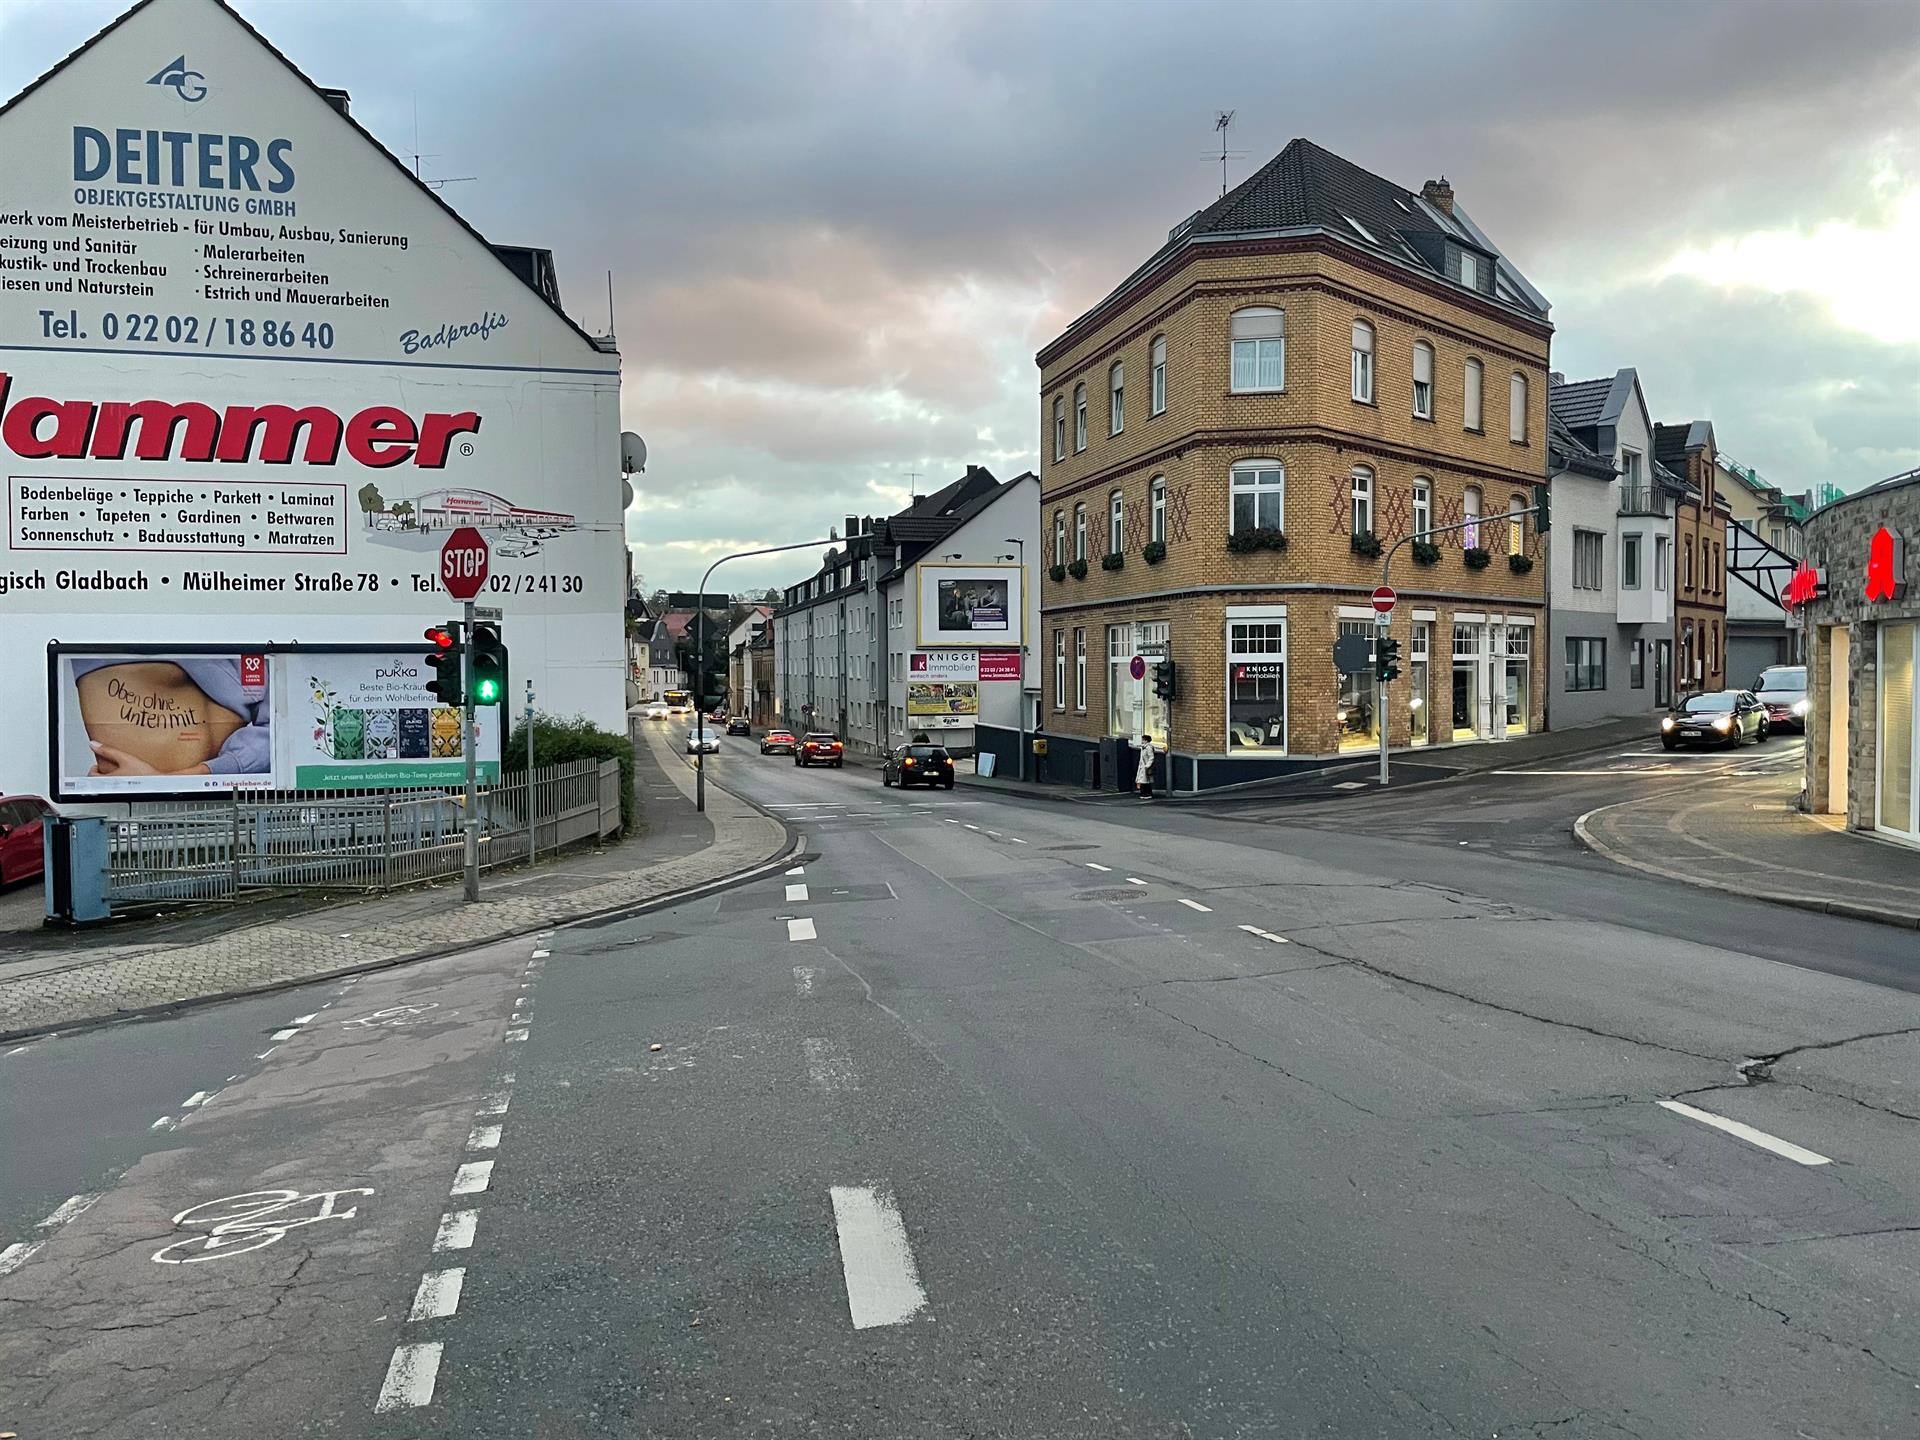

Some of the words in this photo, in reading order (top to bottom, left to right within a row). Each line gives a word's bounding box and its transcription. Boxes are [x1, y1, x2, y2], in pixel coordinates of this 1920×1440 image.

[73, 126, 295, 194] DEITERS
[74, 188, 240, 213] OBJEKTGESTALTUNG
[245, 198, 296, 217] GMBH
[37, 215, 68, 227] vom
[72, 213, 178, 233] Meisterbetrieb
[194, 219, 214, 234] für
[219, 221, 274, 241] Umbau,
[279, 225, 335, 244] Ausbau,
[339, 229, 408, 250] Sanierung
[0, 235, 48, 254] eizung
[53, 237, 80, 252] und
[85, 238, 137, 255] Sanitär
[203, 244, 305, 264] Malerarbeiten
[53, 258, 80, 273] und
[85, 258, 167, 277] Trockenbau
[203, 265, 329, 285] Schreinerarbeiten
[45, 278, 72, 293] und
[78, 279, 154, 297] Naturstein
[204, 285, 250, 301] Estrich
[255, 288, 281, 303] und
[286, 288, 389, 308] Mauerarbeiten
[39, 310, 87, 339] Tel.
[400, 311, 509, 355] Badprofis
[0, 372, 482, 468] ammer
[21, 486, 113, 505] Bodenbeläge
[133, 488, 194, 505] Teppiche
[214, 490, 261, 504] Parkett
[281, 492, 334, 507] Laminat
[446, 497, 484, 506] Hammer
[21, 507, 69, 521] Farben
[96, 508, 150, 525] Tapeten
[177, 510, 241, 524] Gardinen
[267, 511, 334, 526] Bettwaren
[21, 527, 114, 542] Sonnenschutz
[138, 529, 245, 547] Badausstattung
[268, 531, 334, 546] Matratzen
[444, 548, 486, 578] STOP
[56, 569, 148, 590] Gladbach
[183, 571, 286, 591] Mülheimer
[294, 572, 353, 592] Straße
[358, 573, 379, 592] 78
[929, 653, 976, 661] KNIGGE
[376, 667, 418, 680] pukka
[108, 678, 141, 707] Oben
[143, 693, 181, 711] ohne.
[360, 683, 384, 691] Beste
[386, 683, 427, 691] Bio-Kräut
[350, 694, 361, 702] für
[364, 694, 383, 702] dein
[385, 693, 437, 702] Wohlbefinde
[120, 704, 168, 729] Unten
[170, 709, 206, 729] mit.
[365, 771, 398, 779] köstlichen
[429, 770, 461, 779] probieren
